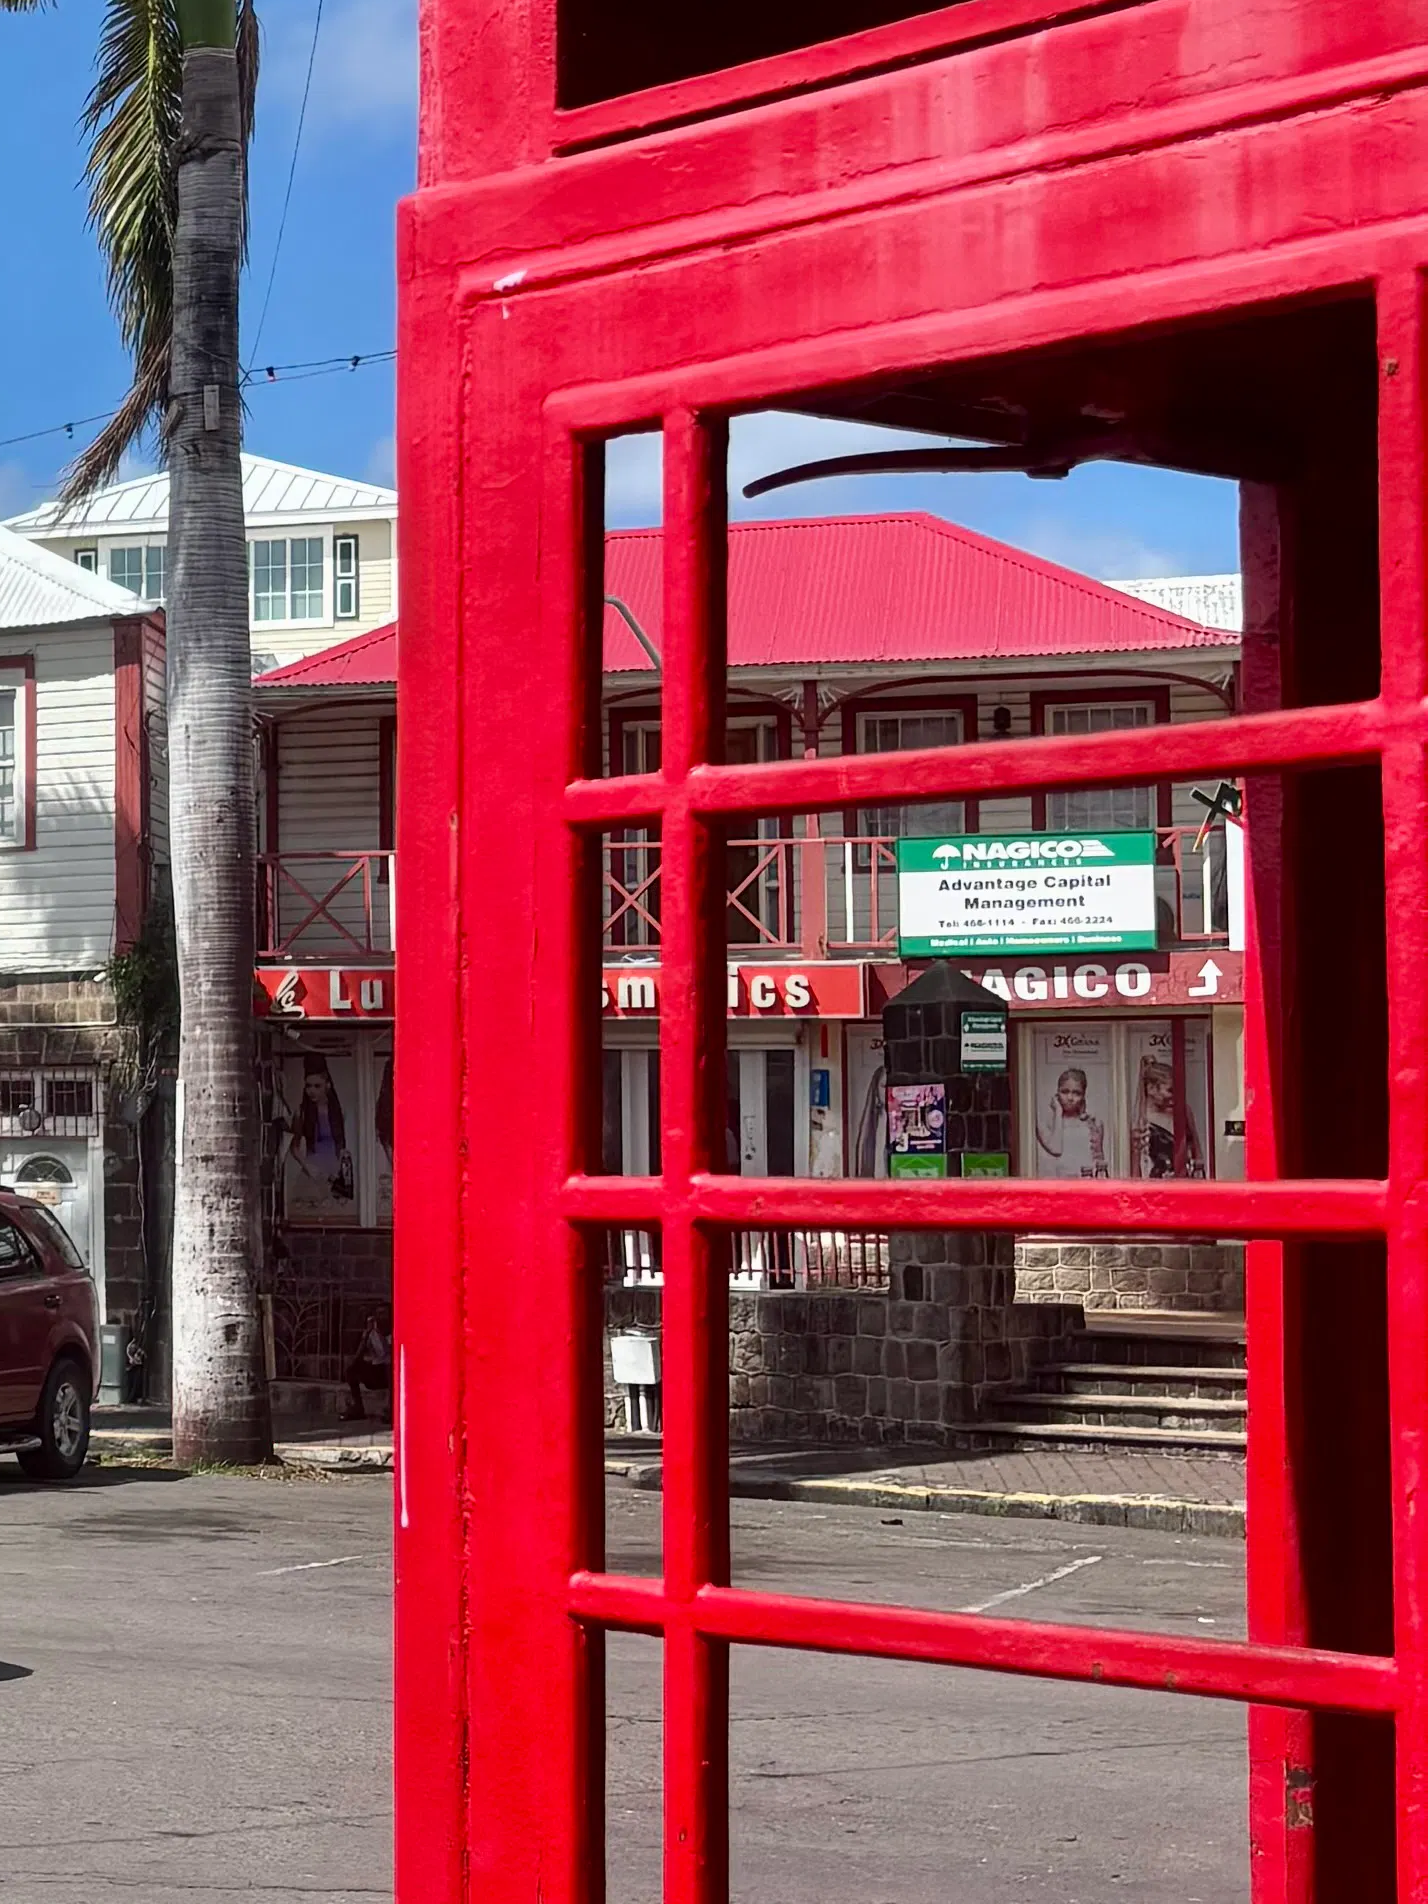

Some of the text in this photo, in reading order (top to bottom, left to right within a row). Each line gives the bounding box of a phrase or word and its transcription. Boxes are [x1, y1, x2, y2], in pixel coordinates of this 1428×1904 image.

[962, 839, 1084, 860] NAGICO
[962, 858, 1082, 870] INSURANCES
[939, 874, 1111, 892] Advantage Capital
[965, 895, 1086, 911] Management
[330, 969, 383, 1010] Lu
[961, 963, 1151, 1002] AGICO
